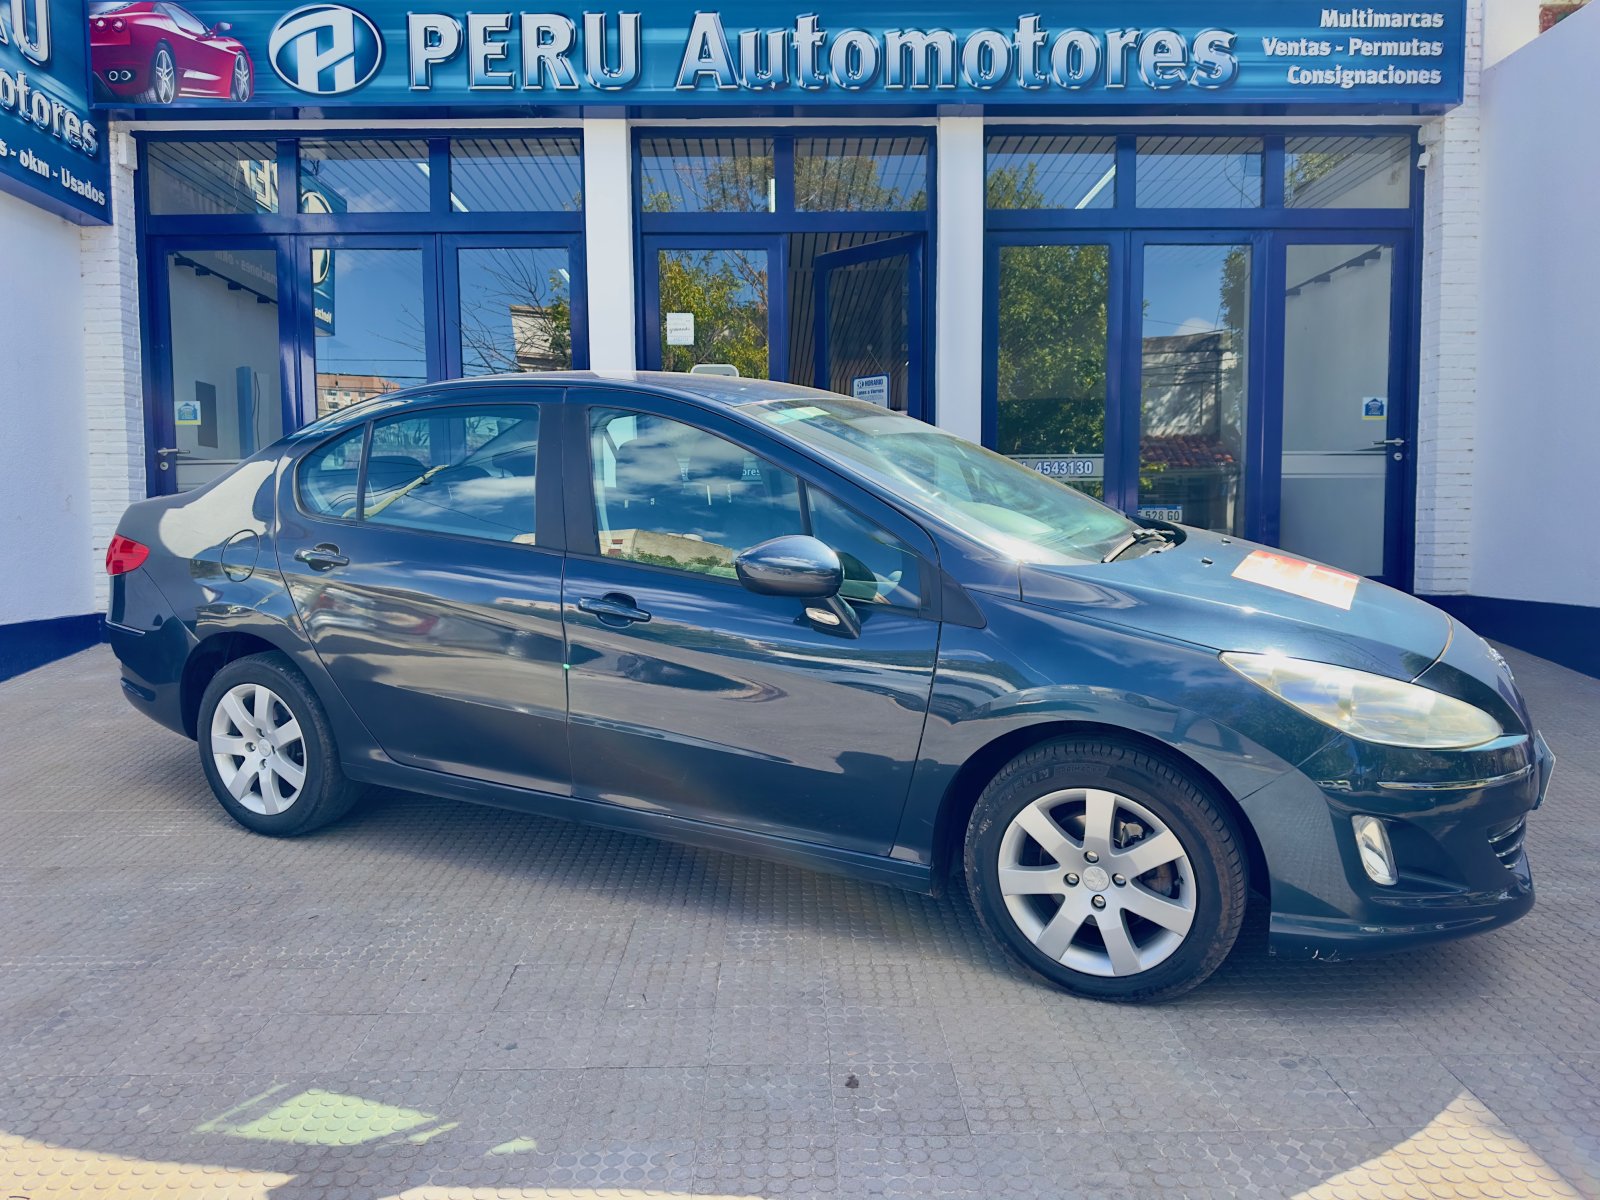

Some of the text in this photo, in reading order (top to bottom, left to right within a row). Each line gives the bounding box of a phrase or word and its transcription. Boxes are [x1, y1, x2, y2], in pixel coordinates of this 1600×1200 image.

[1320, 8, 1444, 28] Multimarcas
[406, 11, 642, 91] PERU
[674, 11, 1238, 91] Automotores
[1261, 37, 1332, 57] Ventas
[1348, 37, 1444, 57] Permutas
[1287, 64, 1442, 89] Consignaciones
[61, 166, 106, 206] Usados
[1034, 460, 1093, 475] 4543130
[1145, 510, 1164, 520] 528
